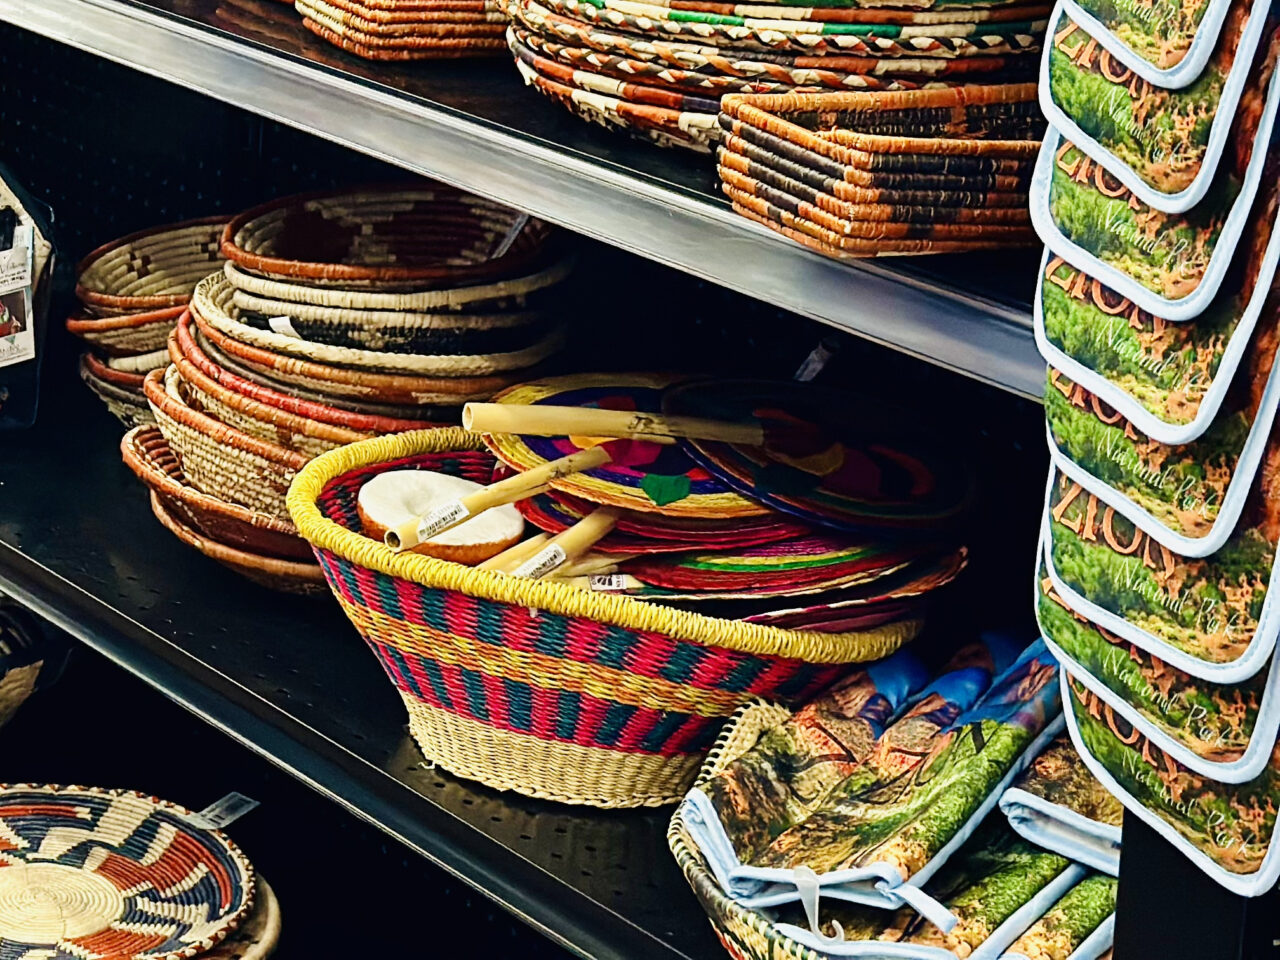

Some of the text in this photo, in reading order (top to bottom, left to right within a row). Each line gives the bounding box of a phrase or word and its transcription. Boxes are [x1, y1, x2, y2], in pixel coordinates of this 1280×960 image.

[1096, 427, 1175, 490] National
[1114, 559, 1190, 615] National
[1101, 647, 1180, 715] National
[1121, 748, 1257, 858] National Park
